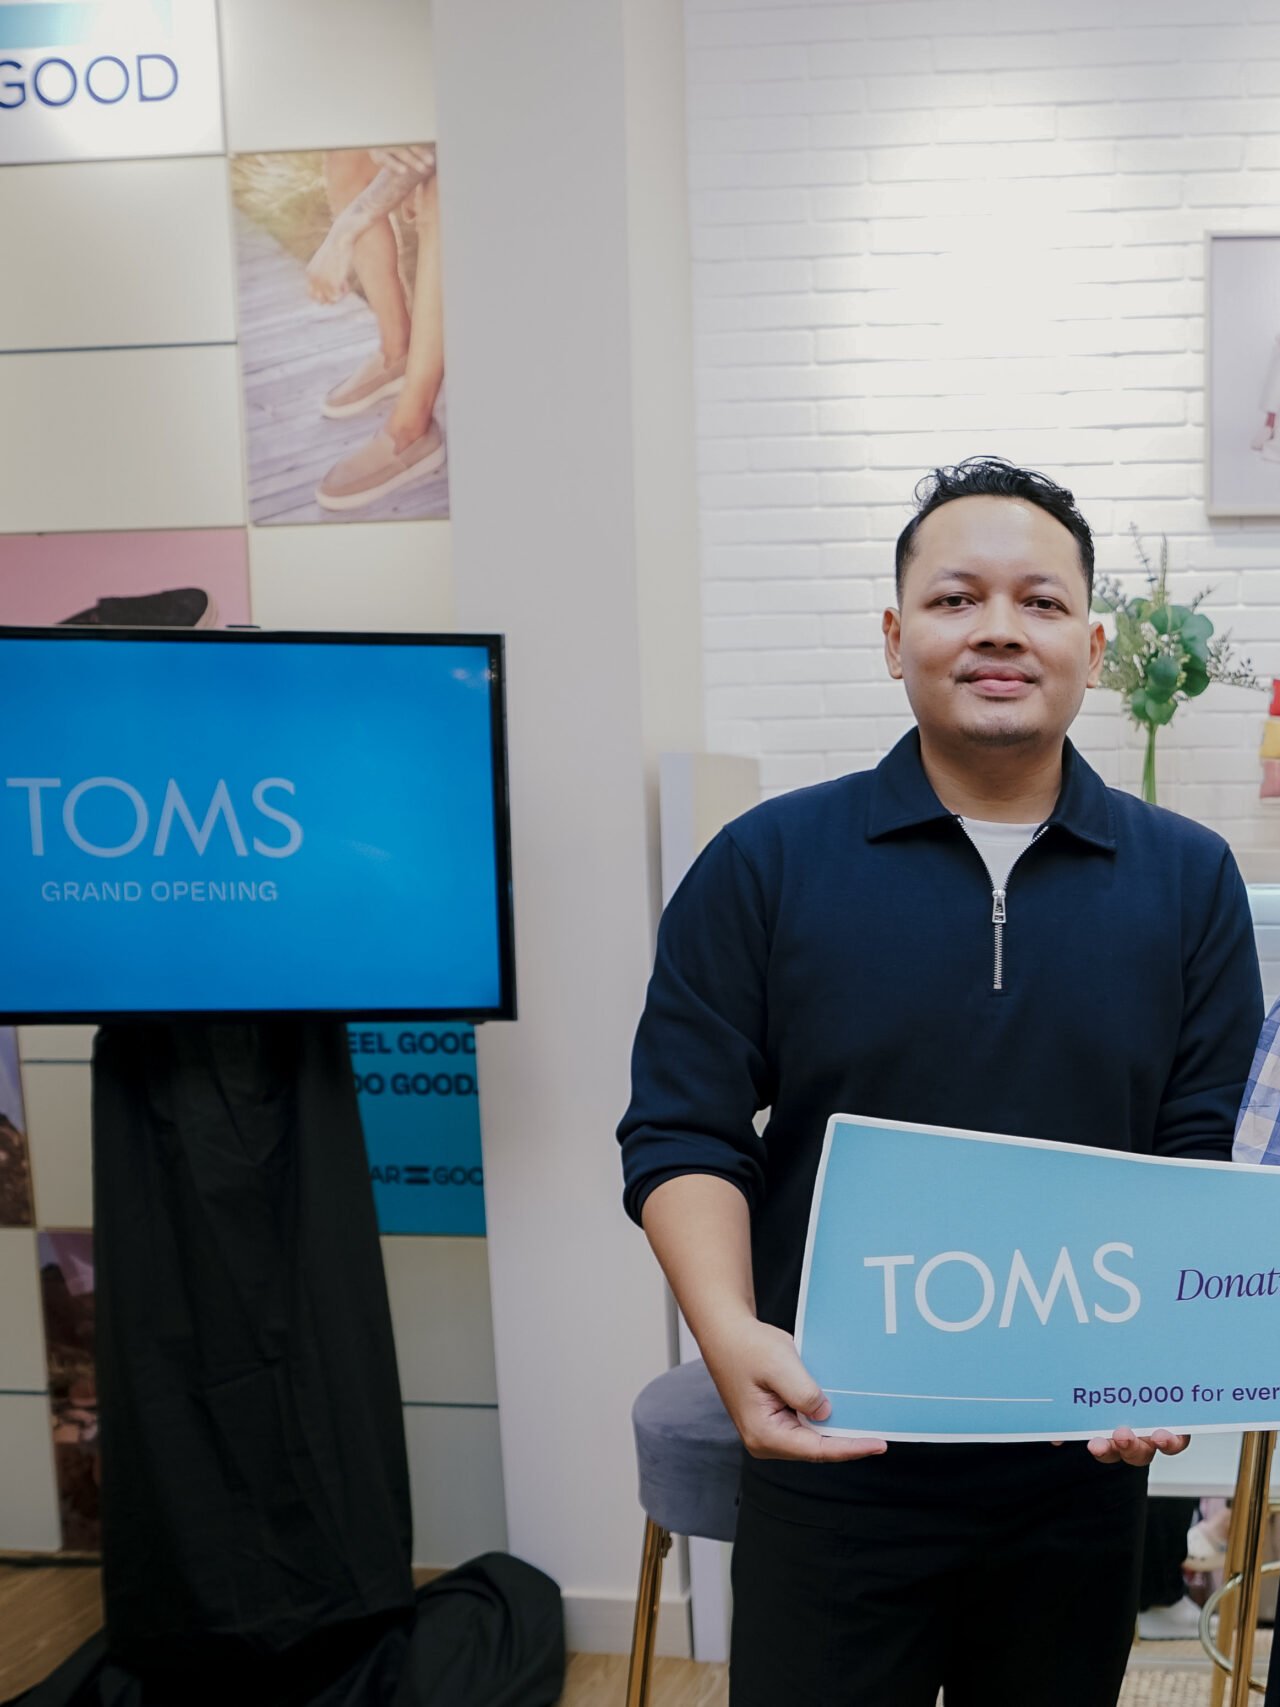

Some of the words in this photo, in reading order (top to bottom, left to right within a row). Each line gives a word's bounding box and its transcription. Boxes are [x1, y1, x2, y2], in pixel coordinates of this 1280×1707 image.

[0, 54, 178, 109] GOOD
[6, 776, 304, 859] TOMS
[41, 881, 142, 901] GRAND
[151, 881, 278, 901] OPENING
[348, 1032, 392, 1054] EEL
[863, 1242, 1141, 1334] TOMS
[1073, 1387, 1184, 1407] Rp50,000
[1192, 1384, 1224, 1402] for
